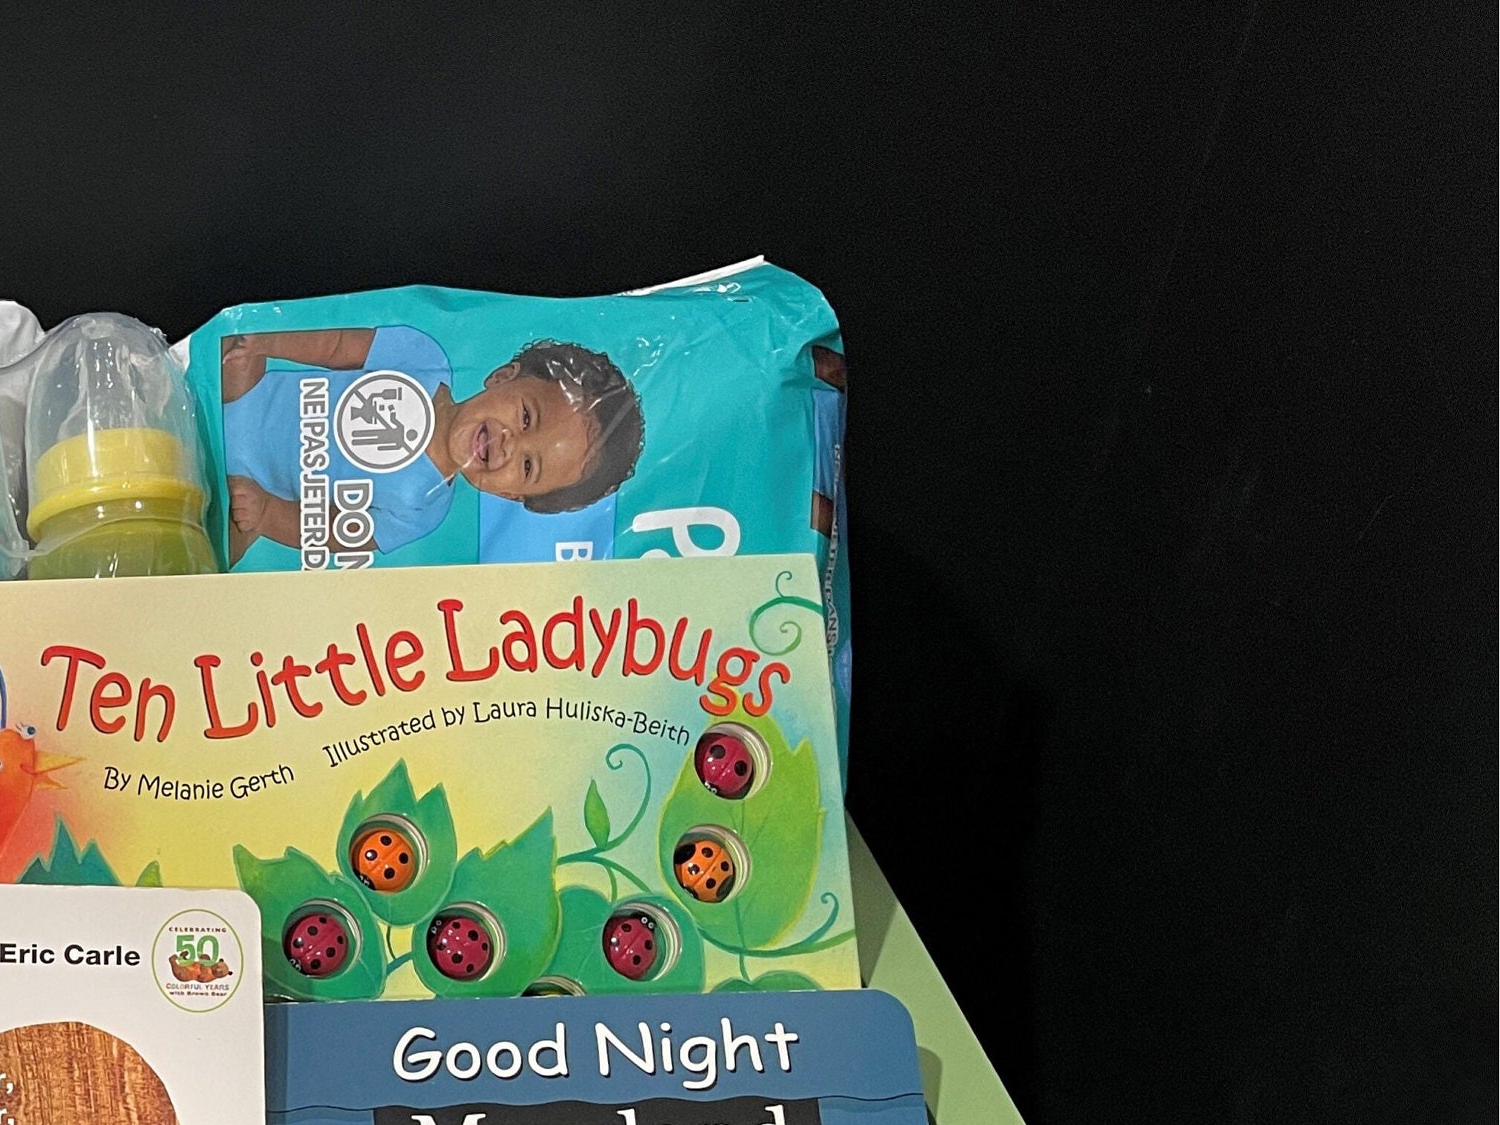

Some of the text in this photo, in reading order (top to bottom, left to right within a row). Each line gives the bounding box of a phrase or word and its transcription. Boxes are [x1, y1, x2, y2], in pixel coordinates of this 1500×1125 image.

[301, 380, 328, 572] NE PAS JETER D
[334, 480, 374, 547] DO
[632, 505, 742, 562] P
[40, 594, 791, 743] Ten Little Ladybugs
[321, 694, 691, 768] Illustrated by Laura Huliska-Beith
[103, 763, 295, 801] By Melanie Gerth
[0, 943, 56, 965] Eric
[64, 944, 142, 967] Carle
[175, 934, 220, 967] 50
[165, 982, 203, 991] COLORFUL
[392, 1017, 800, 1090] Good Night
